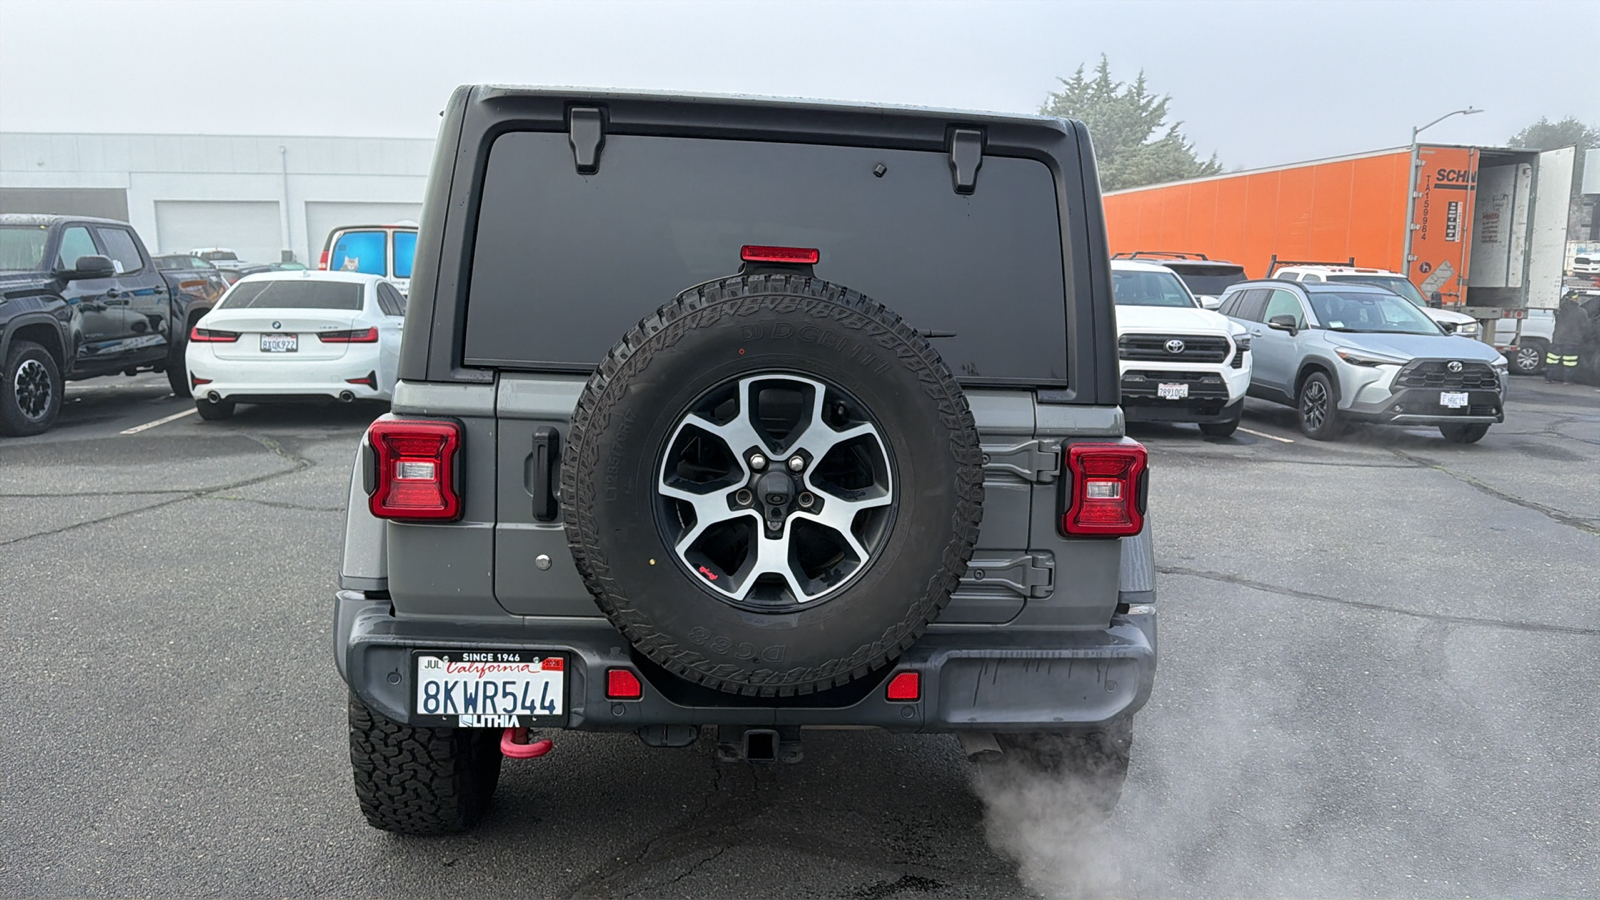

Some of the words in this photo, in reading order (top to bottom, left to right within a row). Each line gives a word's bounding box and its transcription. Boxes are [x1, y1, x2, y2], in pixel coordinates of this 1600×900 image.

[687, 626, 786, 663] DC88
[424, 660, 441, 669] JUL
[463, 653, 493, 662] SINCE
[497, 653, 520, 662] 1946
[446, 661, 541, 679] California
[423, 680, 556, 714] 8KWR544
